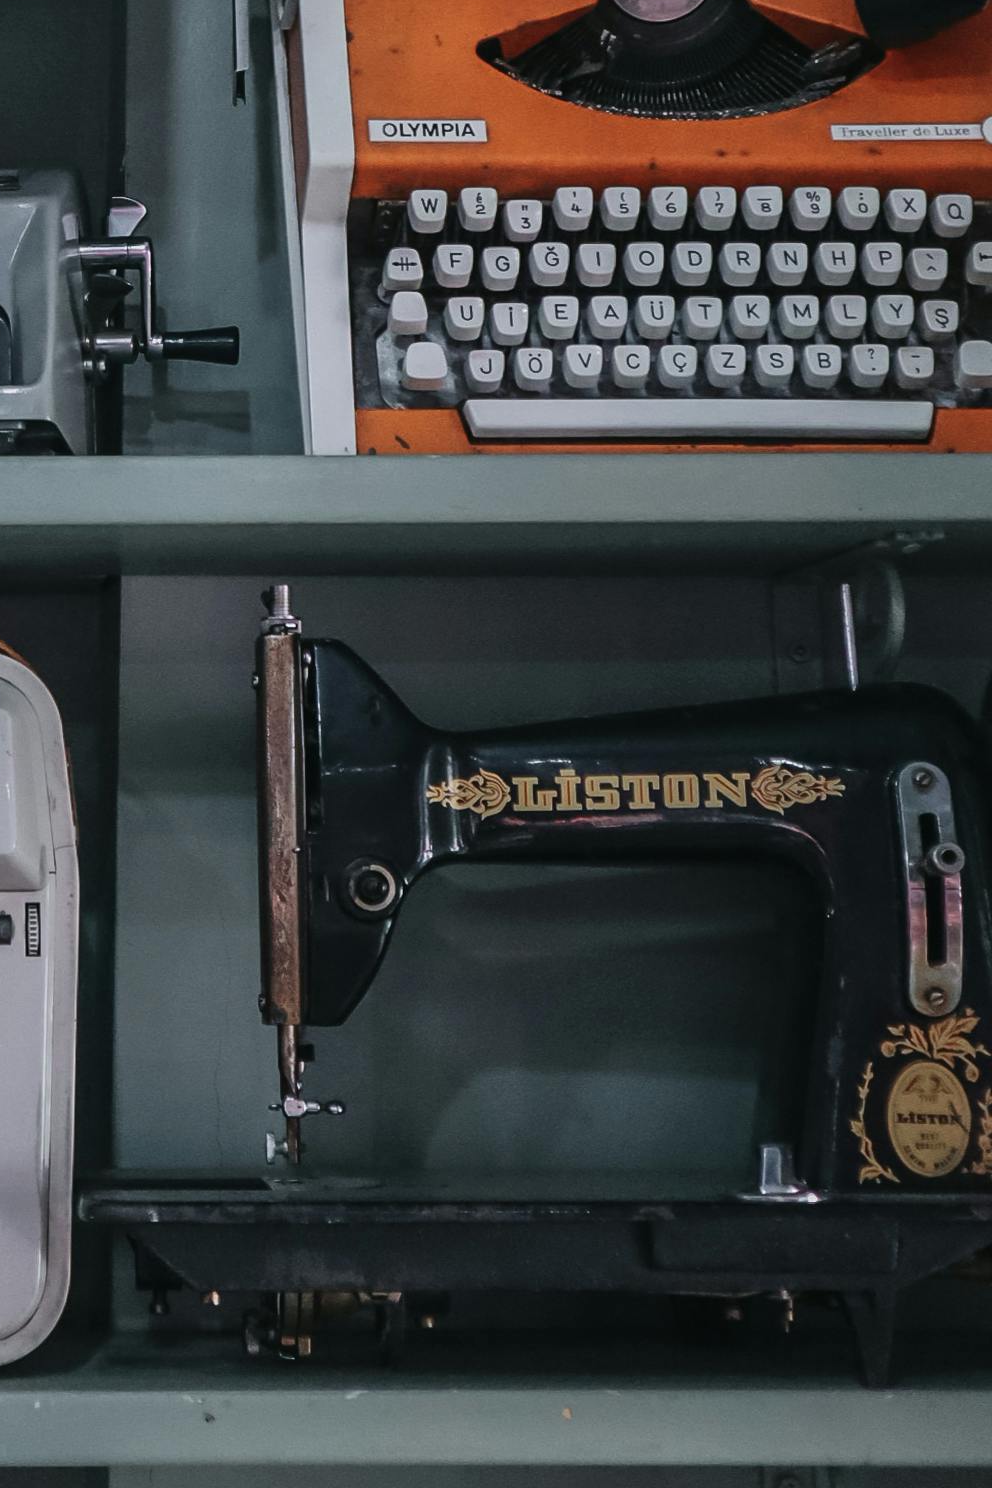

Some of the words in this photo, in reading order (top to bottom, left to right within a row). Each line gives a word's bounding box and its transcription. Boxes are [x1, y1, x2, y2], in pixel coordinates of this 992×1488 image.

[382, 121, 476, 139] OLYMPIA
[840, 125, 908, 137] Traveller
[912, 126, 931, 137] de
[935, 125, 971, 137] Luxe
[420, 197, 439, 214] W
[475, 201, 486, 215] 2
[520, 217, 532, 230] 3
[571, 203, 583, 213] 4
[619, 203, 630, 214] 5
[665, 202, 677, 214] 6
[714, 202, 724, 214] 7
[760, 202, 772, 213] 8
[810, 203, 821, 215] 9
[902, 197, 917, 213] X
[947, 203, 965, 220] Q
[449, 252, 463, 268] F
[495, 255, 510, 272] G
[544, 245, 560, 268] Ğ
[638, 250, 655, 267] O
[687, 250, 703, 267] D
[736, 250, 751, 266] R
[783, 250, 798, 266] N
[831, 250, 847, 266] H
[878, 250, 893, 266] P
[459, 304, 474, 322] U
[554, 303, 569, 320] E
[604, 304, 620, 320] A
[649, 300, 664, 321] Ü
[697, 303, 712, 320] T
[746, 303, 760, 319] K
[792, 303, 812, 319] M
[842, 303, 857, 320] L
[889, 303, 904, 319] Y
[934, 308, 950, 329] Ş
[479, 358, 492, 375] J
[528, 353, 543, 374] Ö
[578, 353, 592, 368] V
[626, 353, 641, 370] C
[671, 352, 687, 374] Ç
[720, 351, 736, 369] Z
[769, 352, 784, 369] S
[817, 352, 832, 369] B
